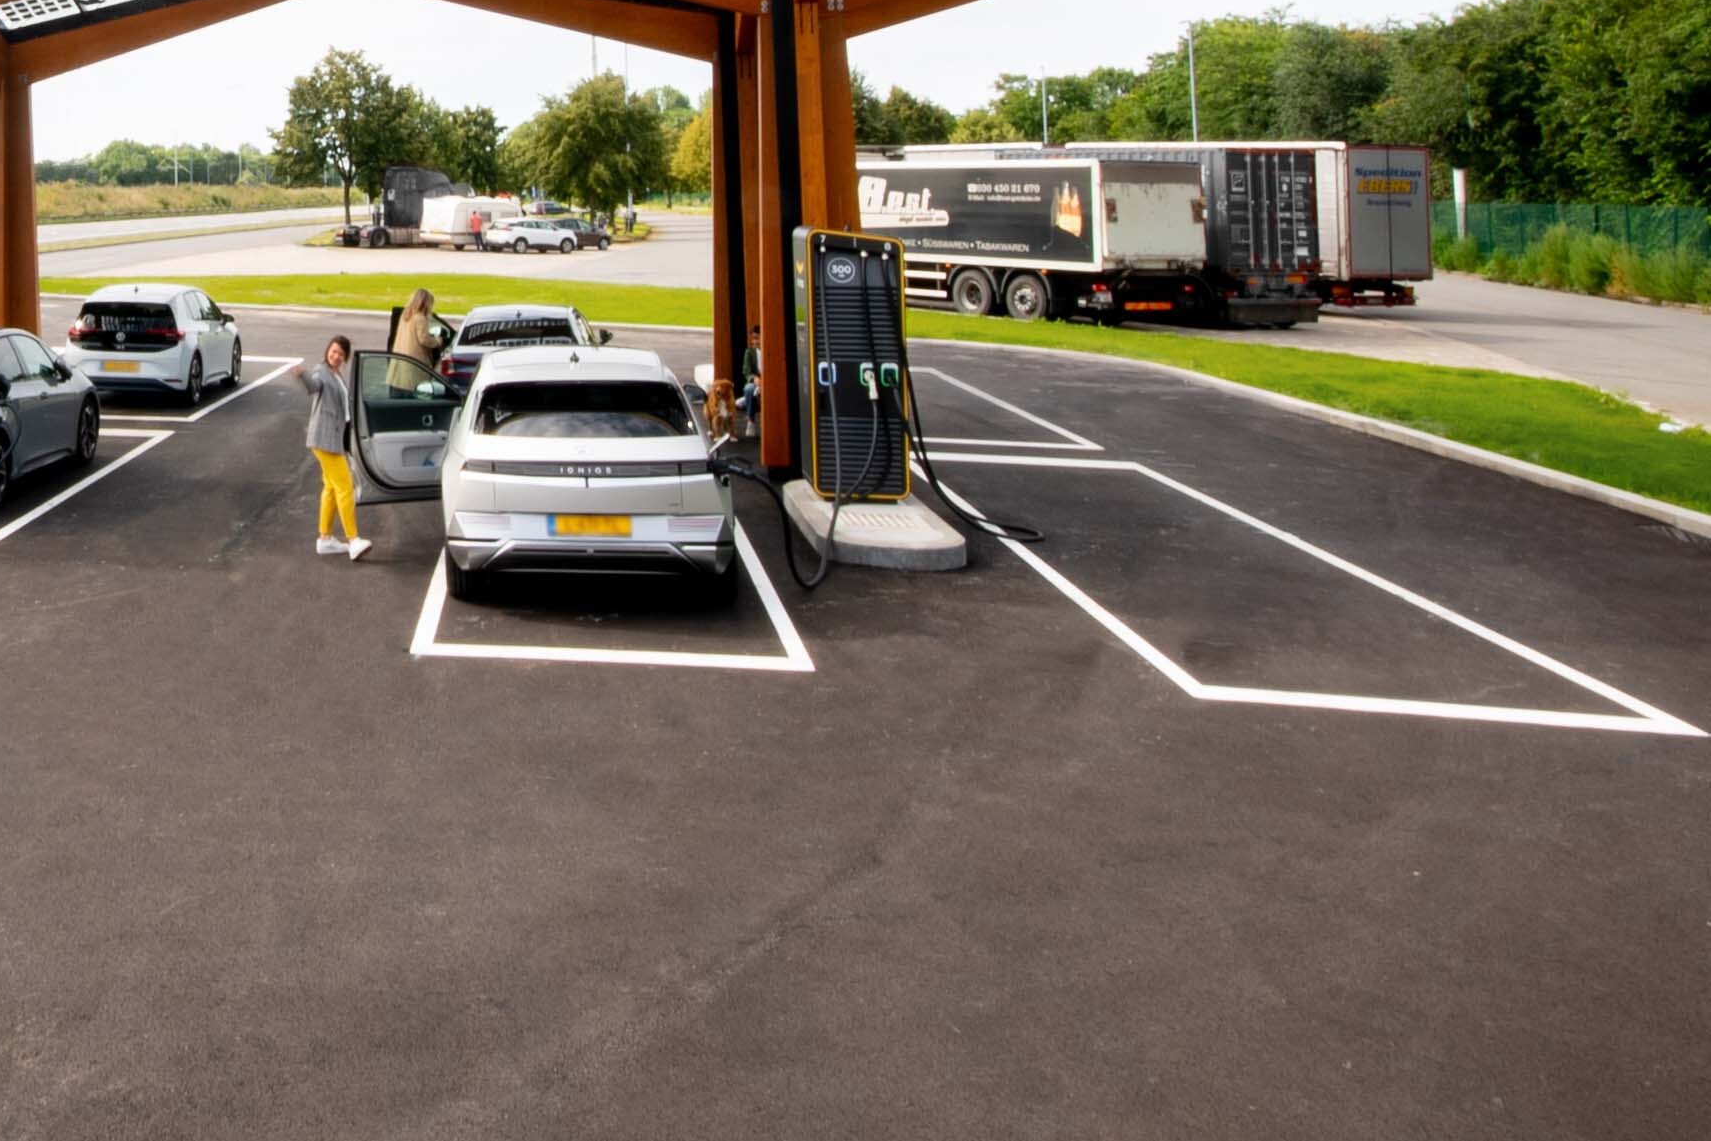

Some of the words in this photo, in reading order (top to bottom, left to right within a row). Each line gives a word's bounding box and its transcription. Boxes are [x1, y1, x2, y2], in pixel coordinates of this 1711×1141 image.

[1354, 166, 1421, 178] Spedition
[820, 234, 826, 243] 7
[831, 264, 852, 275] 300
